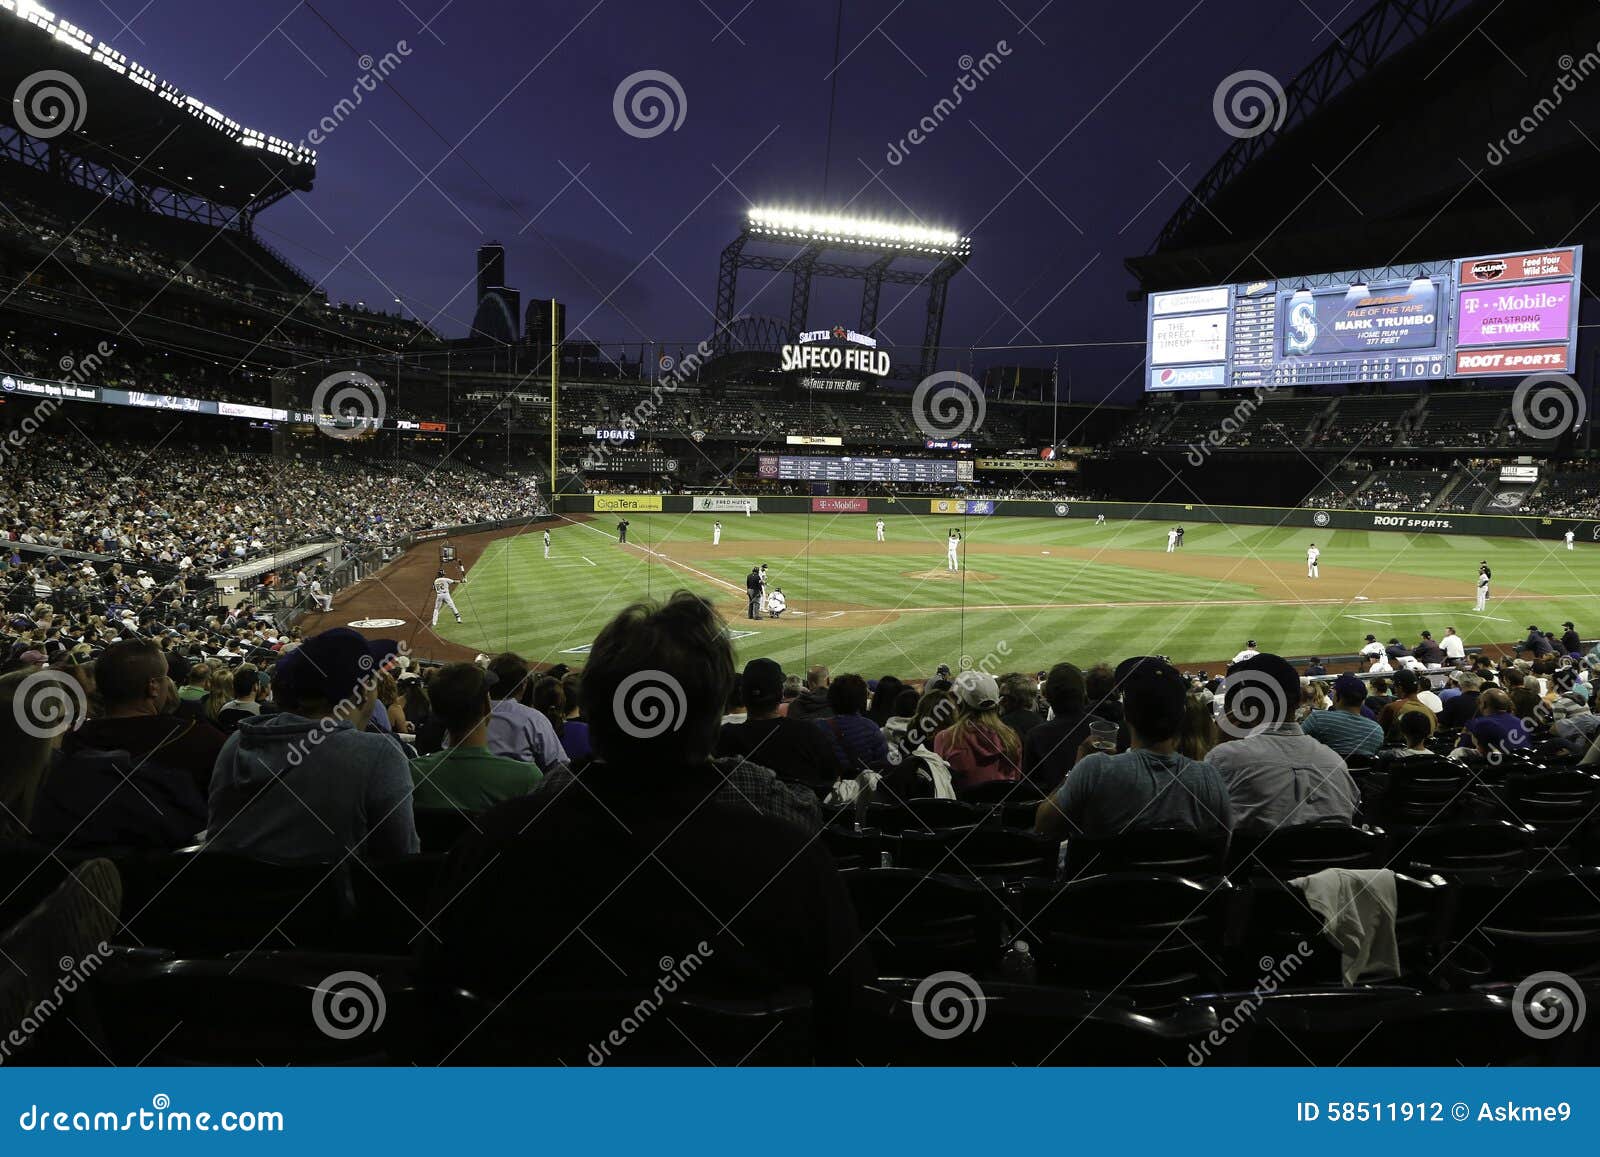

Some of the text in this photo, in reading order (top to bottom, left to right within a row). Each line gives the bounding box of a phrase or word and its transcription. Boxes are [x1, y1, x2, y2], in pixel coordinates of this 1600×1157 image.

[1523, 256, 1560, 267] Feed Your
[1523, 265, 1560, 275] Wild Side.
[1346, 310, 1365, 318] TALE
[1382, 307, 1398, 315] THE
[1401, 304, 1424, 314] TAPE
[1335, 314, 1434, 331] MARK TRUMBO
[1482, 314, 1541, 325] DATA STRONG
[1358, 330, 1380, 339] HOME
[1381, 329, 1398, 337] RUN
[1481, 322, 1540, 335] NETWORK
[1380, 336, 1400, 344] FEET
[782, 345, 891, 376] SAFECO FIELD
[1458, 354, 1504, 368] ROOT
[1400, 363, 1441, 376] 1 0 0
[834, 381, 845, 390] THE
[597, 499, 638, 510] GigaTera
[1373, 516, 1407, 526] ROOT
